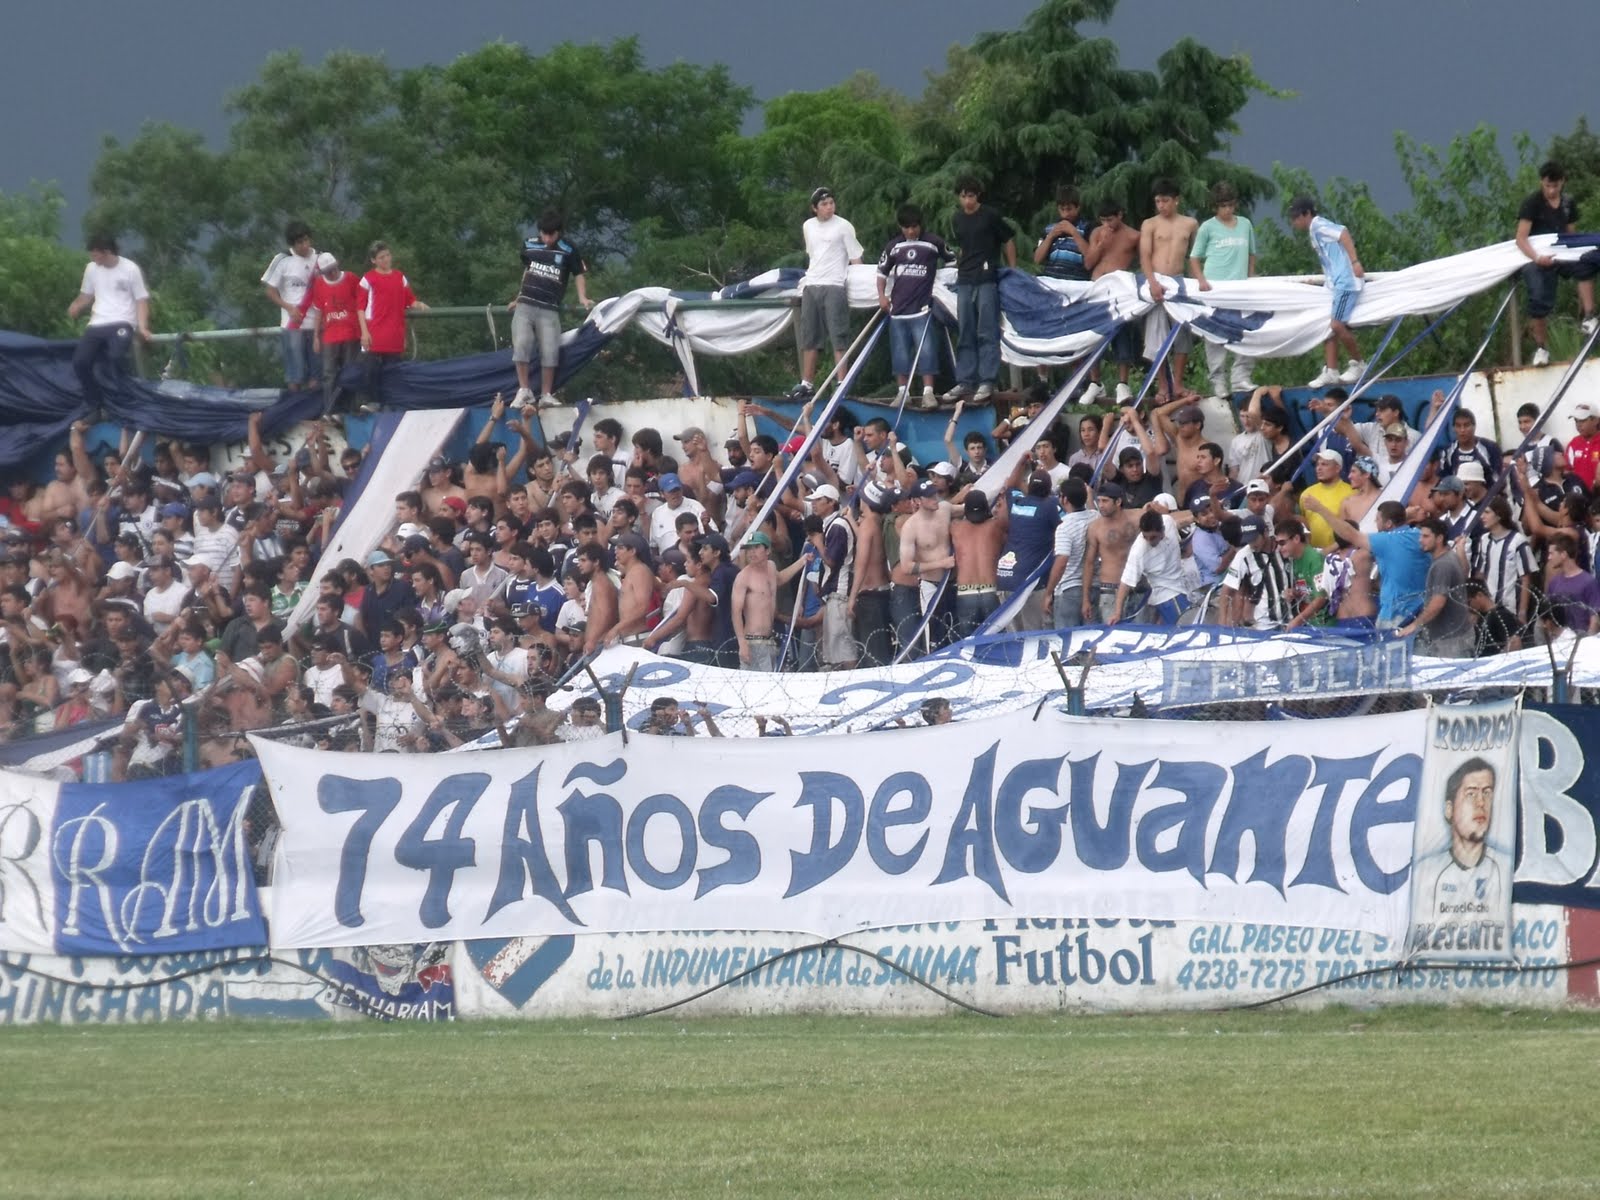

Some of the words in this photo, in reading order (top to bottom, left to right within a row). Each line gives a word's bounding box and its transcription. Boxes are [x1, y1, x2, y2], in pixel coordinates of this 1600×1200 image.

[1434, 713, 1515, 751] RODRIGO
[316, 771, 491, 929] 74
[992, 931, 1156, 986] Futbol
[1318, 928, 1363, 955] DEL
[641, 946, 843, 988] INDUMENTARIA
[846, 954, 871, 986] de
[874, 944, 979, 986] SANMA
[1176, 958, 1306, 990] 4238-7275
